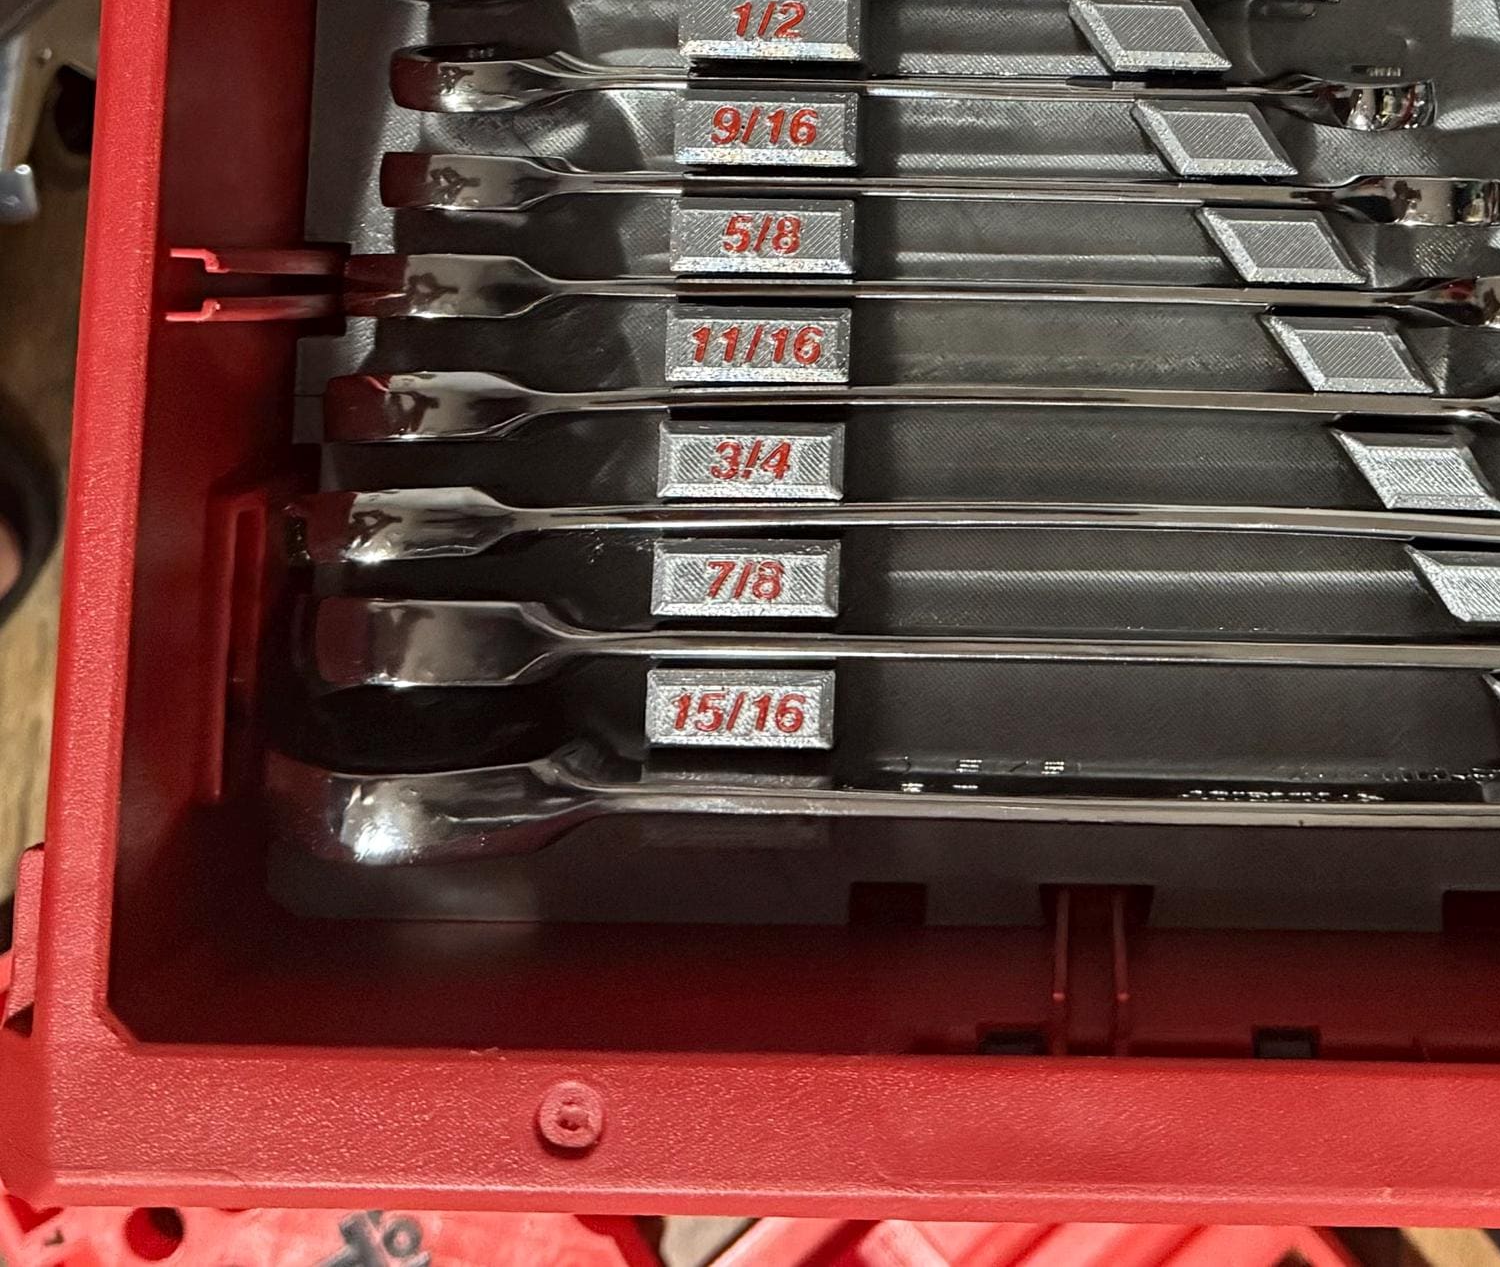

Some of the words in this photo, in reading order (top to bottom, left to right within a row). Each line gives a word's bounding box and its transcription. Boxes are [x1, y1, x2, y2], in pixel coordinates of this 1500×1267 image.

[733, 2, 806, 37] 1/2
[711, 107, 817, 144] 9/16
[723, 216, 801, 253] 5/8
[691, 326, 824, 365] 11/16
[710, 440, 792, 479] 3/4
[709, 561, 784, 599] 7/8
[672, 693, 805, 732] 15/16
